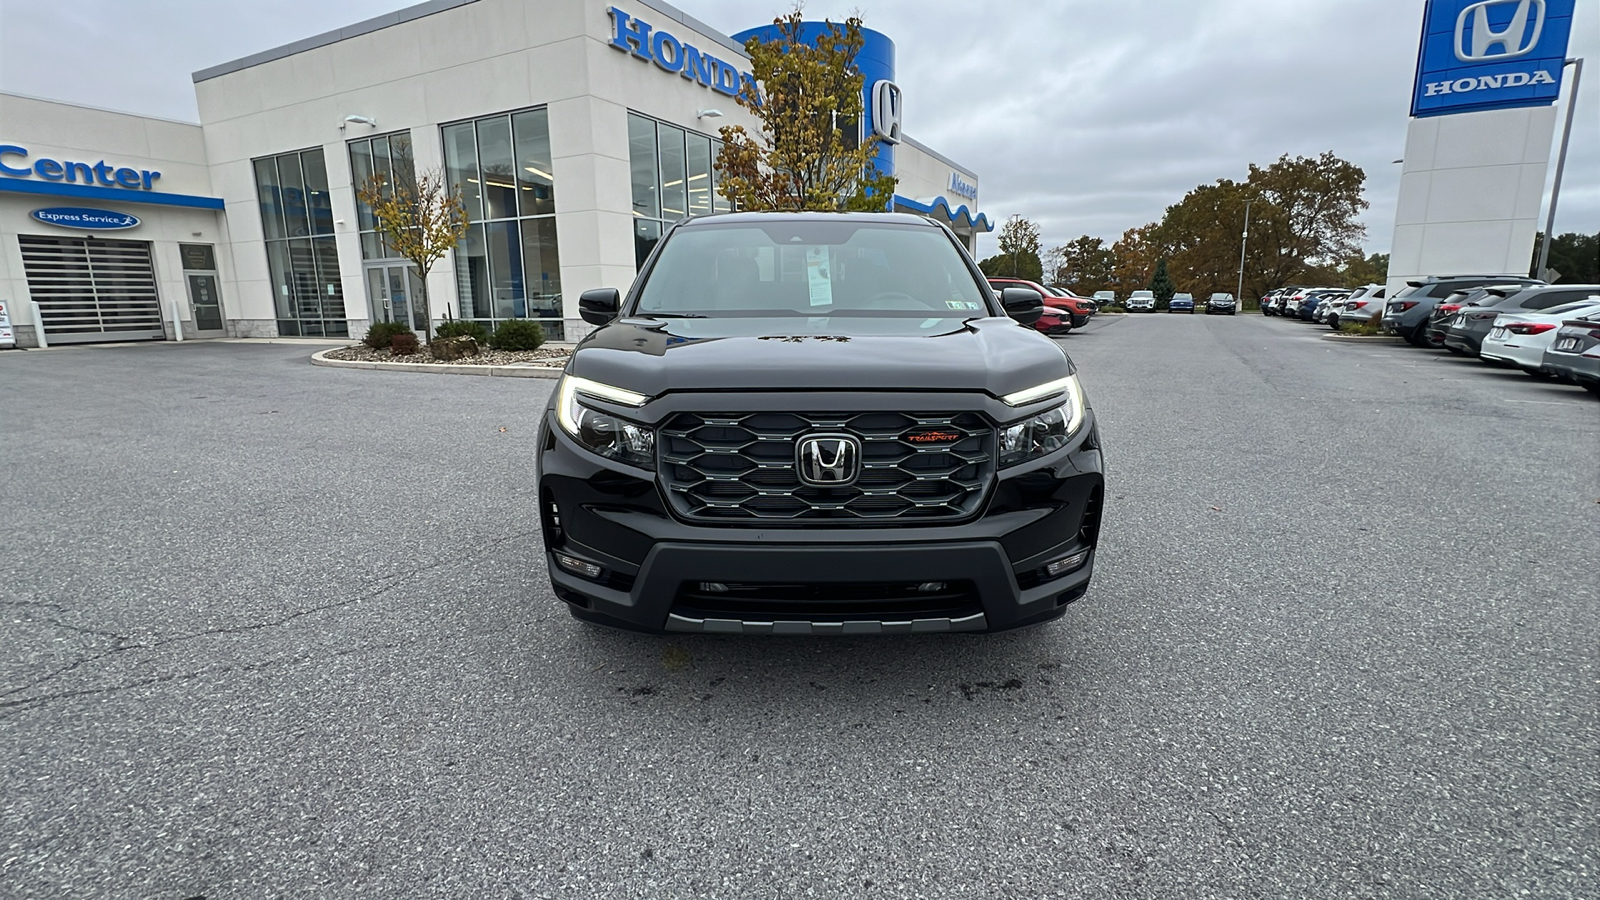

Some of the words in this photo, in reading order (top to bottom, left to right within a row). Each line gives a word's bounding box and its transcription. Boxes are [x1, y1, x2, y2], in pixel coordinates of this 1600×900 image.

[607, 6, 763, 107] HONDA
[1424, 70, 1556, 96] HONDA
[0, 144, 161, 190] Center
[38, 211, 80, 222] Express
[82, 214, 120, 224] Service
